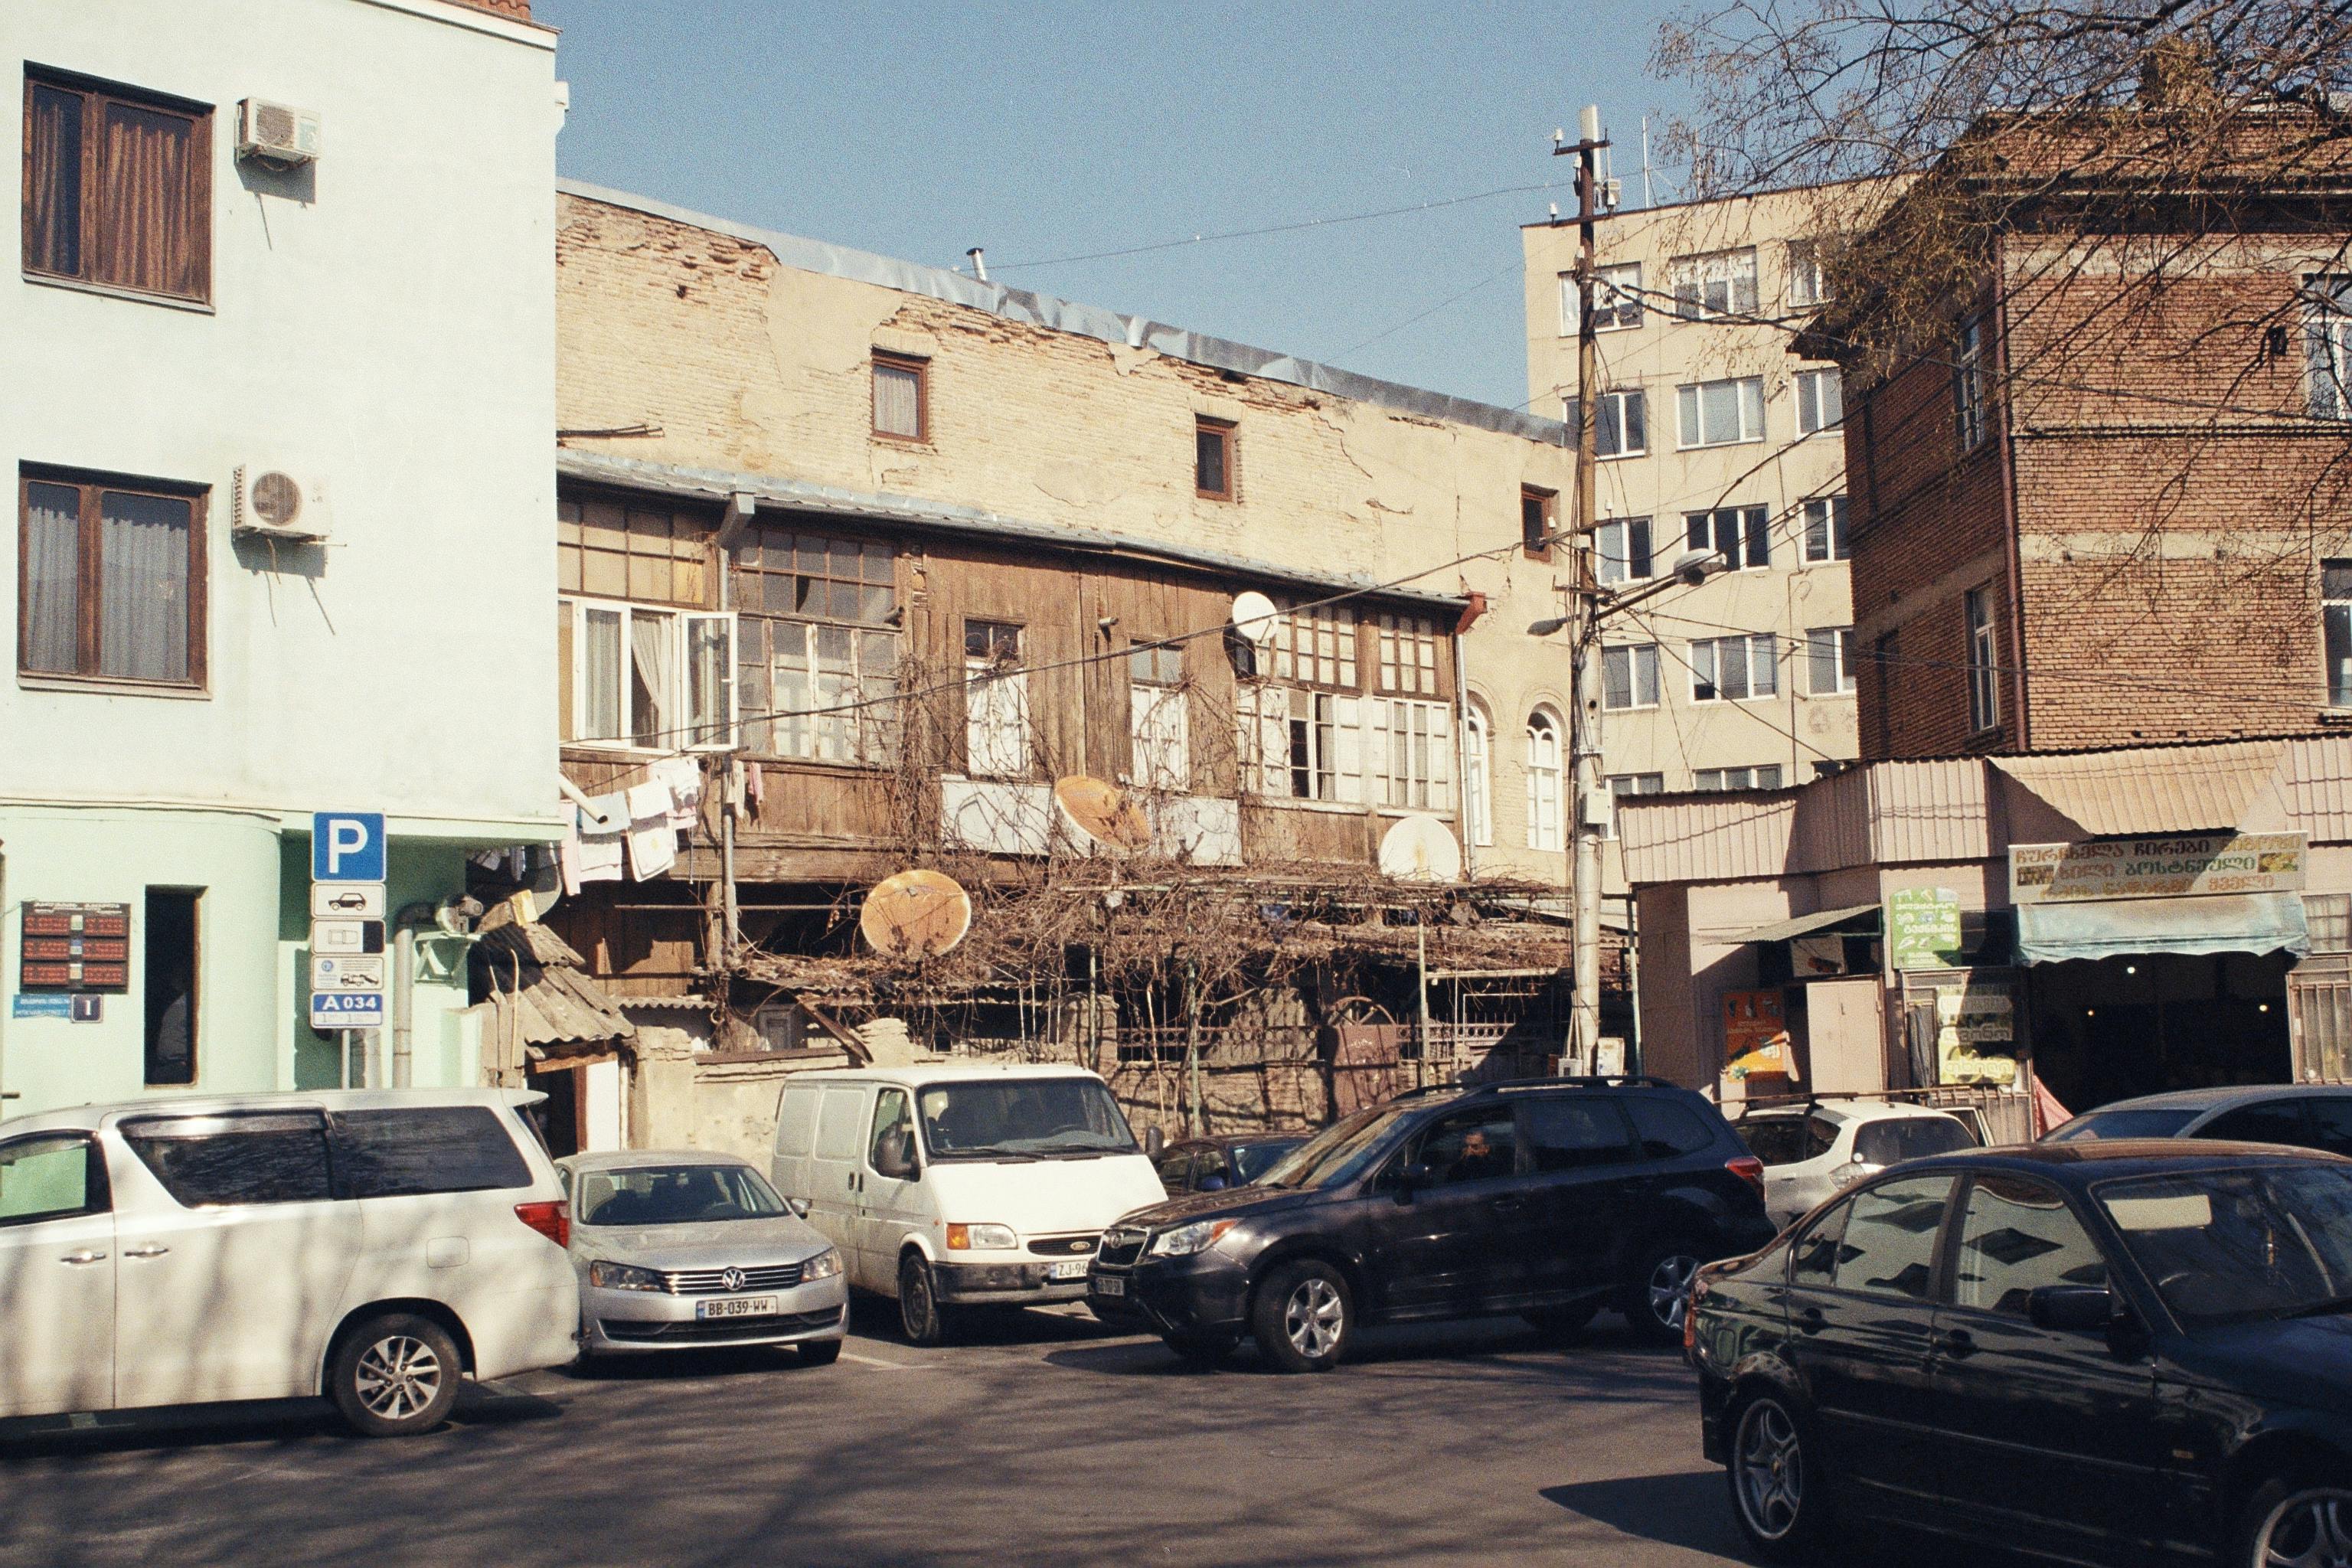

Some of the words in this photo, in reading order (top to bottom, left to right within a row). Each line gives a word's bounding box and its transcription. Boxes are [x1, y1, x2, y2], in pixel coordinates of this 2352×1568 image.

[329, 819, 368, 874] P
[2135, 839, 2210, 856] ჩირები
[2125, 857, 2256, 875] ბოსტნეული
[2209, 875, 2274, 891] ყველი
[322, 995, 340, 1010] A
[343, 997, 377, 1009] 034
[708, 1300, 768, 1316] BB-039-WW
